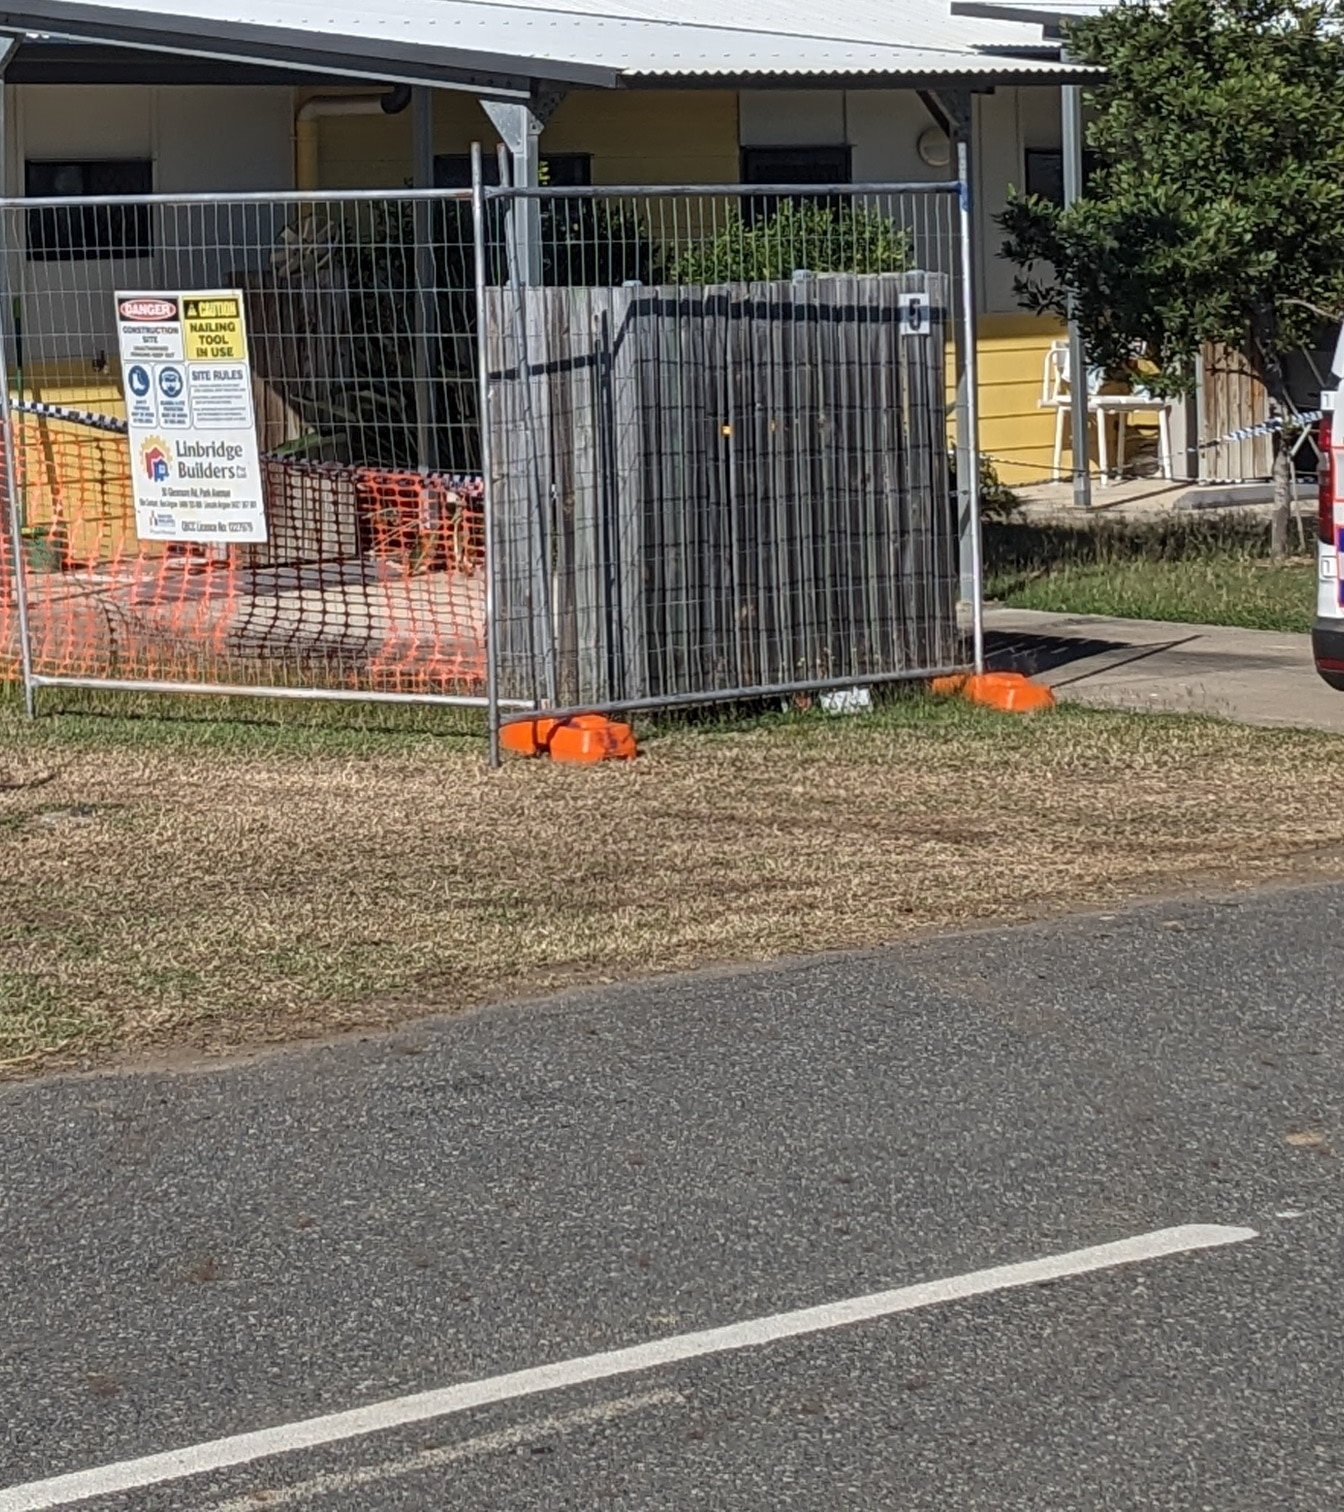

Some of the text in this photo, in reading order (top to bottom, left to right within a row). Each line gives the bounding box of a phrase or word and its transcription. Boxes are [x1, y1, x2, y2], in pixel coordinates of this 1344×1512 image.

[124, 303, 171, 316] DANGER
[198, 301, 237, 317] CAUTION
[909, 298, 922, 331] 5
[122, 326, 179, 335] CONSTRUCTION
[189, 321, 236, 333] NAILING
[142, 336, 158, 344] SITE
[198, 334, 229, 345] TOOL
[196, 346, 234, 358] IN USE
[192, 369, 243, 381] SITE RULES
[176, 439, 243, 461] Linbridge
[178, 461, 236, 479] Builders
